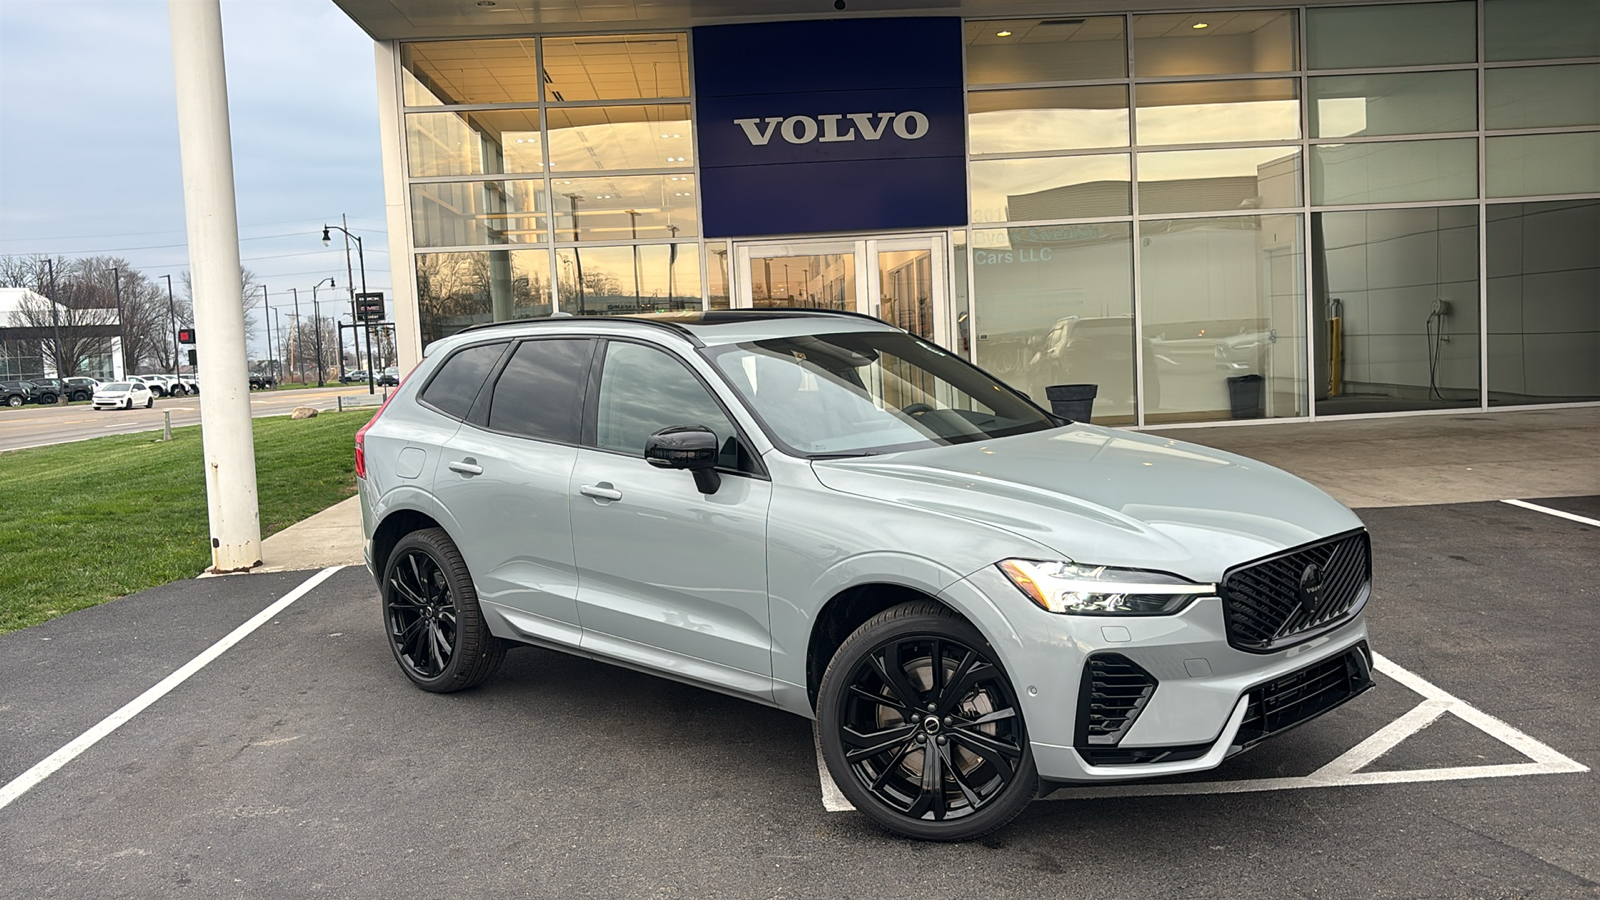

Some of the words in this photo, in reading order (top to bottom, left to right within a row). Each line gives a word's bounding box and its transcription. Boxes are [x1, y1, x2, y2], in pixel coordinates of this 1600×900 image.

[733, 110, 930, 146] VOLVO
[974, 250, 1014, 265] Cars
[1019, 247, 1053, 262] LLC
